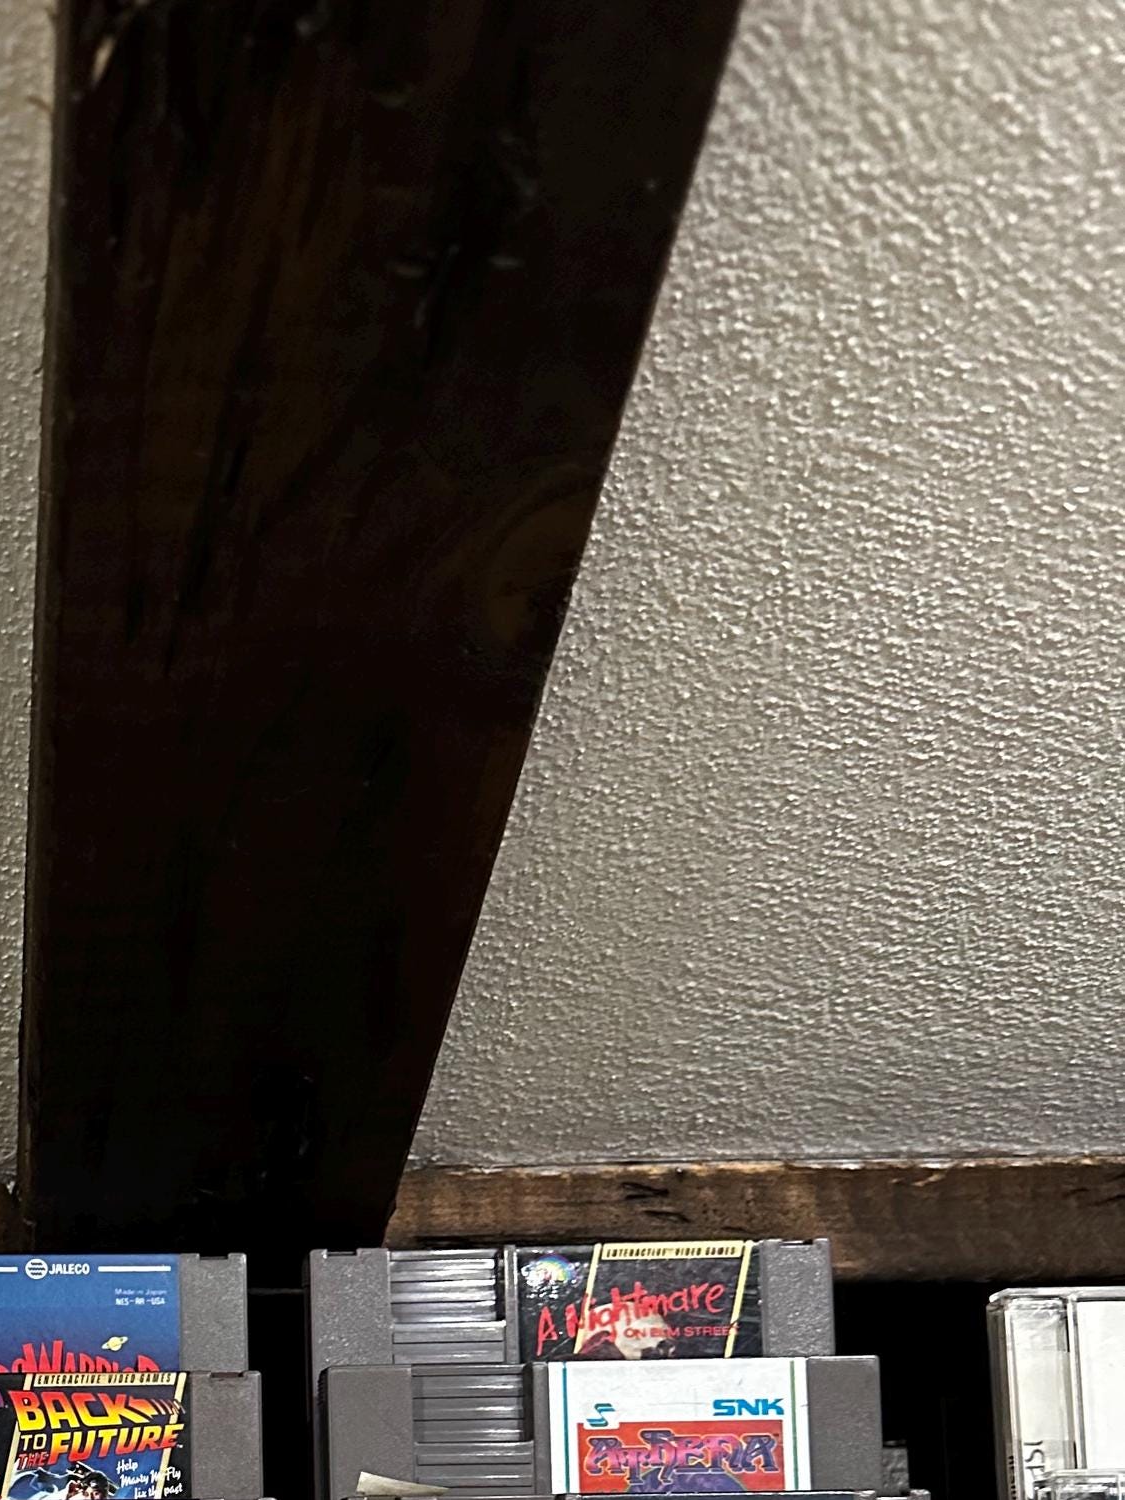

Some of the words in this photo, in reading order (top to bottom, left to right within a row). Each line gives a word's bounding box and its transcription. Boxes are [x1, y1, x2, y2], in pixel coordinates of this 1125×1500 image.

[48, 1263, 90, 1275] JALECO
[565, 1281, 725, 1342] Nightmare
[108, 1374, 135, 1384] VIDEO
[139, 1373, 172, 1383] GAMES
[8, 1390, 155, 1431] BACK
[713, 1398, 784, 1416] SNK
[21, 1434, 47, 1450] TO
[48, 1424, 185, 1465] FUTURE
[116, 1458, 139, 1473] Help
[163, 1482, 183, 1496] past
